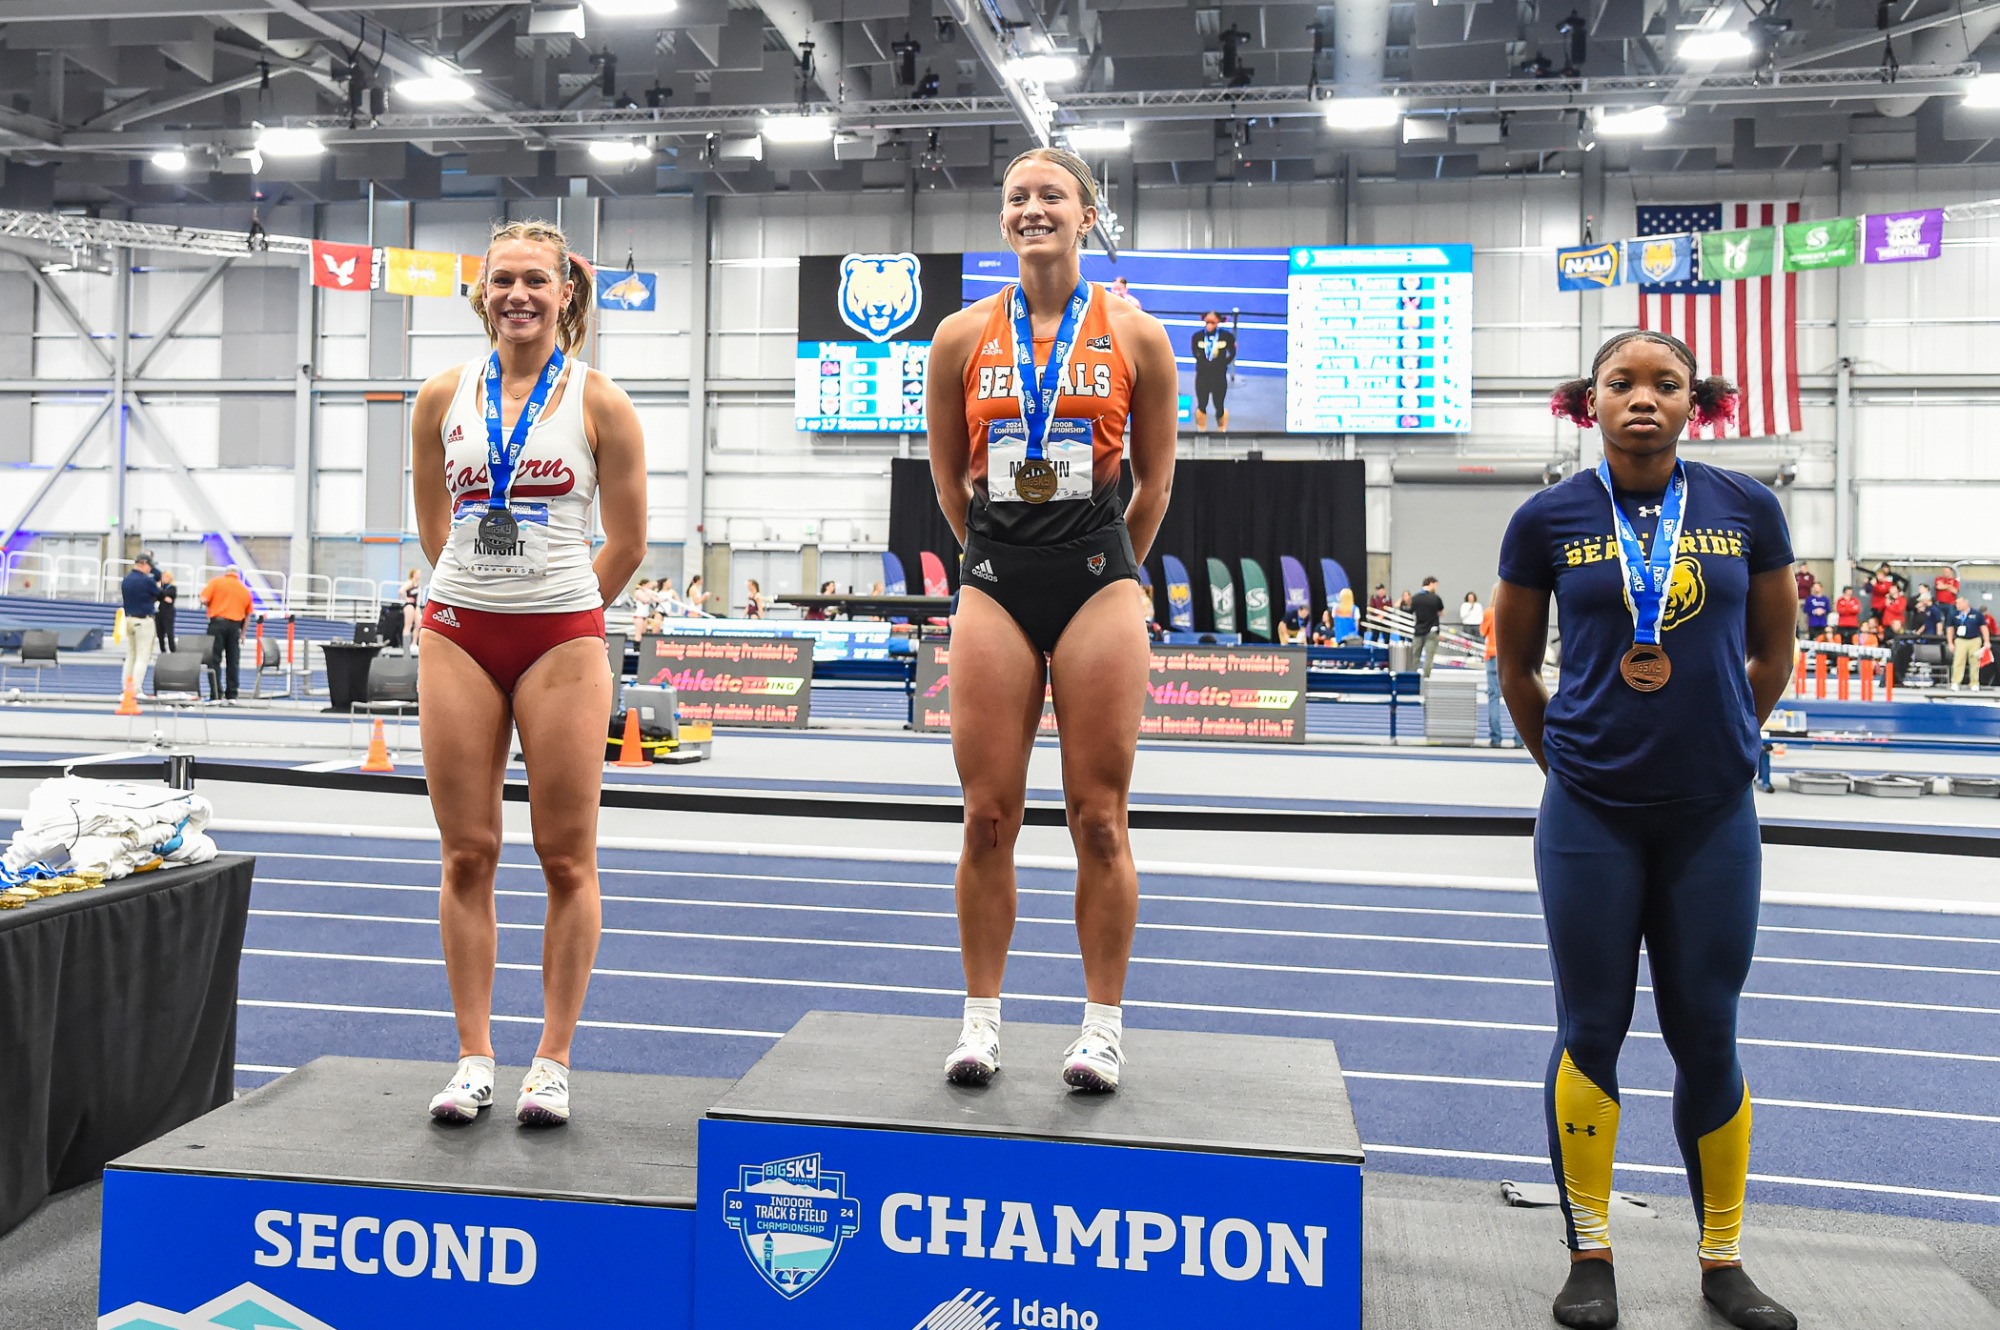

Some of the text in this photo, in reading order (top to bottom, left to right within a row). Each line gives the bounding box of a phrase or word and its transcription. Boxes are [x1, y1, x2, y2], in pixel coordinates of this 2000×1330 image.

[1564, 254, 1612, 274] NAU
[978, 363, 1112, 400] BEALS
[993, 427, 1025, 435] CONFERE
[446, 457, 565, 494] Easrn
[1009, 461, 1069, 478] MIN
[1564, 528, 1742, 550] NORTHN LORADO
[1678, 535, 1742, 557] RIDE
[971, 568, 998, 584] adidas
[432, 613, 461, 628] adidas
[686, 641, 704, 658] and
[704, 641, 742, 663] Scoring
[742, 642, 783, 661] Provided
[1167, 652, 1187, 670] and
[1187, 652, 1227, 675] Scoring
[1228, 653, 1273, 672] Provided
[649, 667, 743, 693] Athletic
[765, 1157, 817, 1179] BIGSKY
[729, 1200, 743, 1209] 20
[770, 1196, 812, 1208] INDOOR
[755, 1205, 828, 1223] TRACK & FIELD
[840, 1209, 854, 1218] 24
[757, 1221, 825, 1233] CHAMPIONSHIP
[254, 1209, 538, 1286] SECOND
[880, 1192, 1328, 1288] CHAMPION
[1012, 1298, 1098, 1330] Idaho
